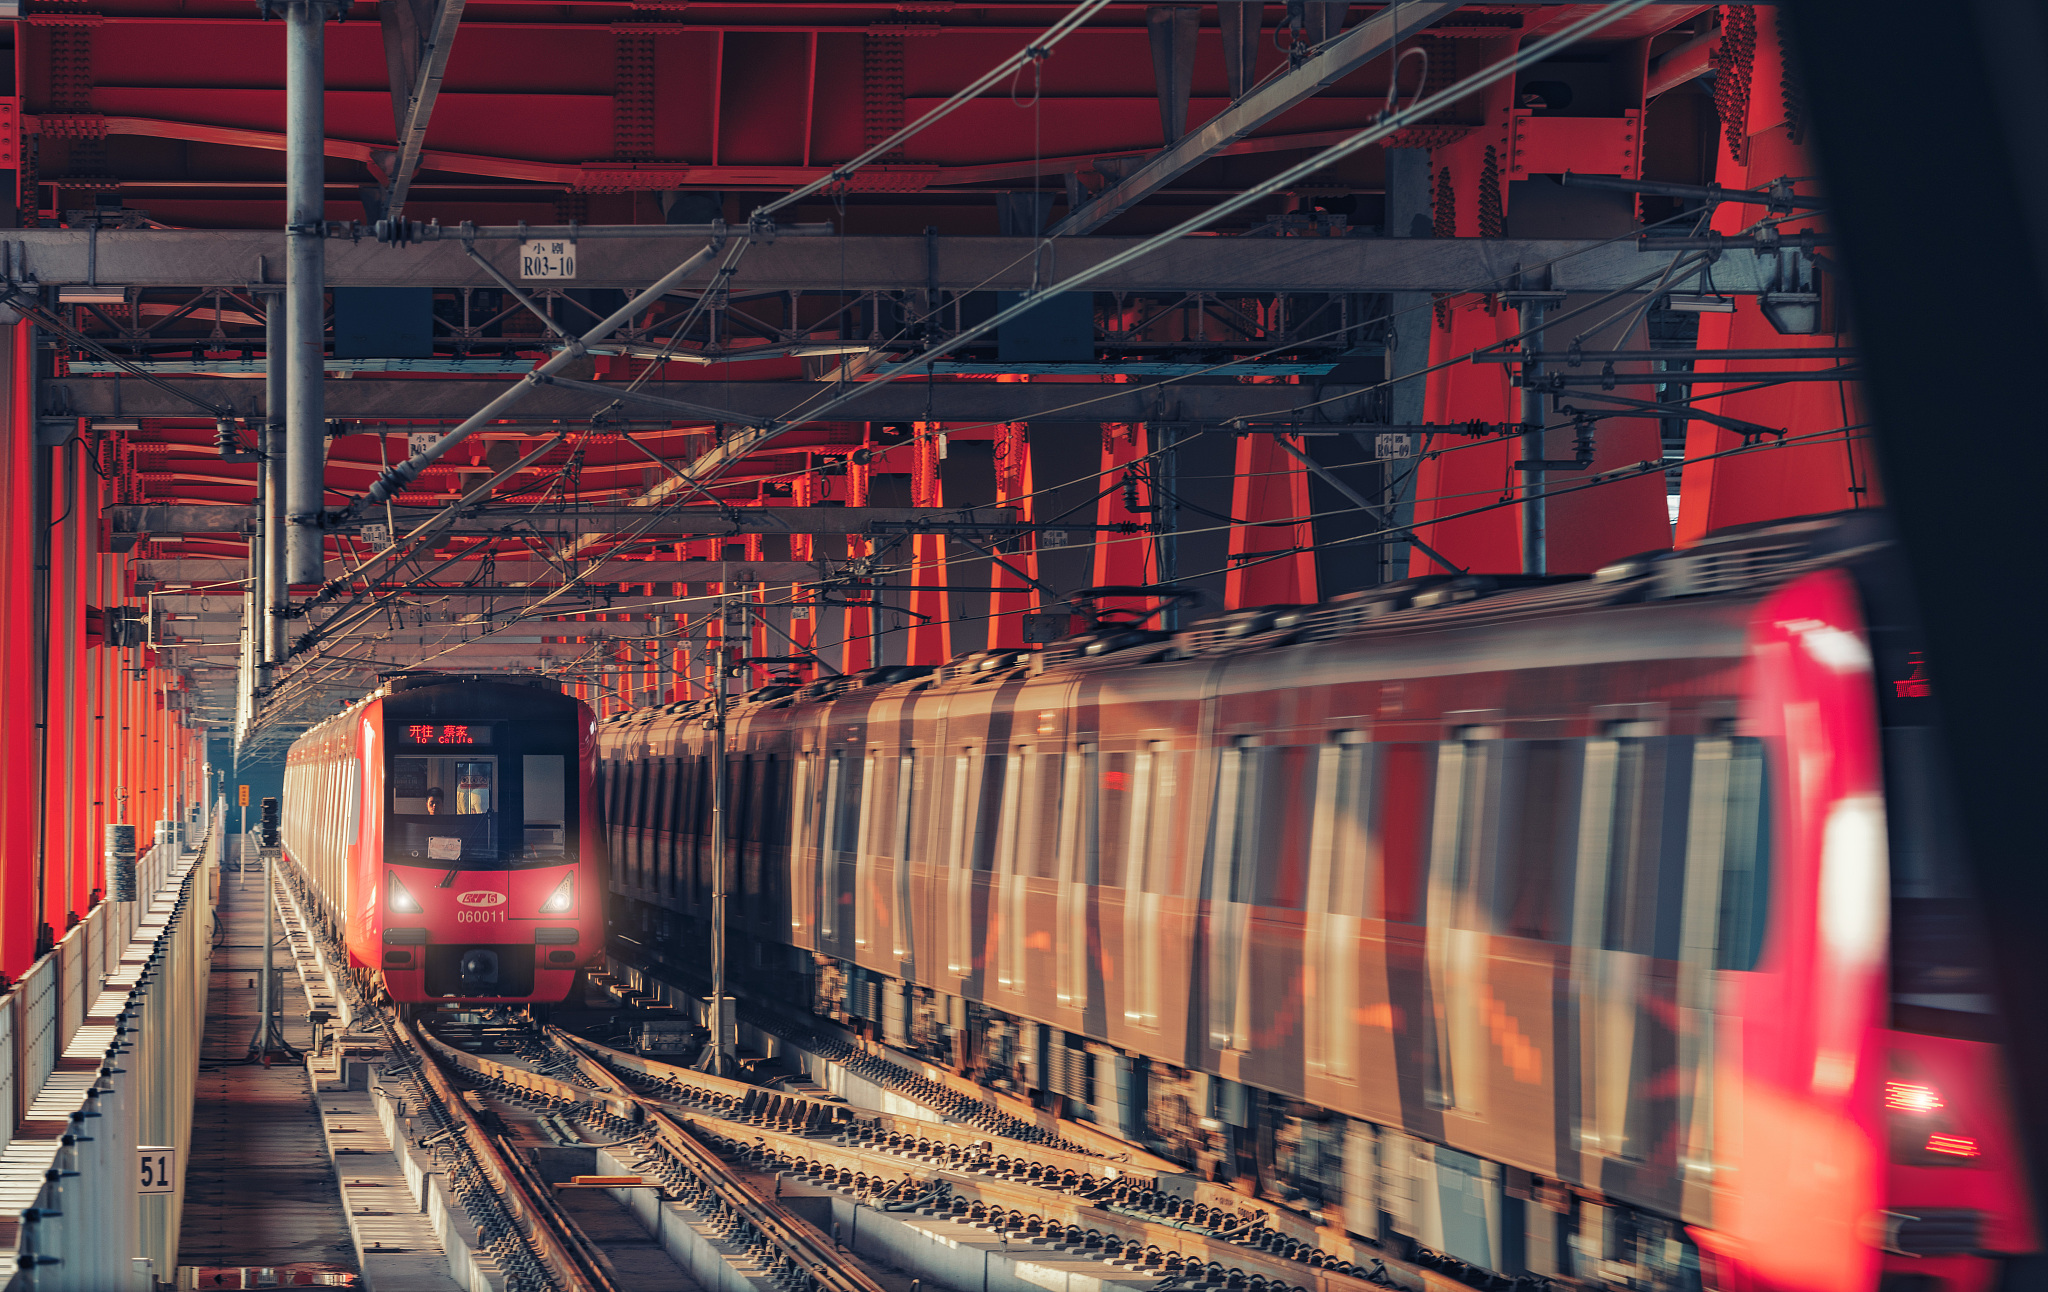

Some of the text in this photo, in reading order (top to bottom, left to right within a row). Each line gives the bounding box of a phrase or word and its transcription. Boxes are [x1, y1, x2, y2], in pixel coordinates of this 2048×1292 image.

[524, 256, 574, 276] R03-10
[409, 724, 468, 737] 开往 蔡家
[416, 736, 428, 744] To
[457, 910, 505, 923] 060011
[141, 1156, 169, 1187] 51
